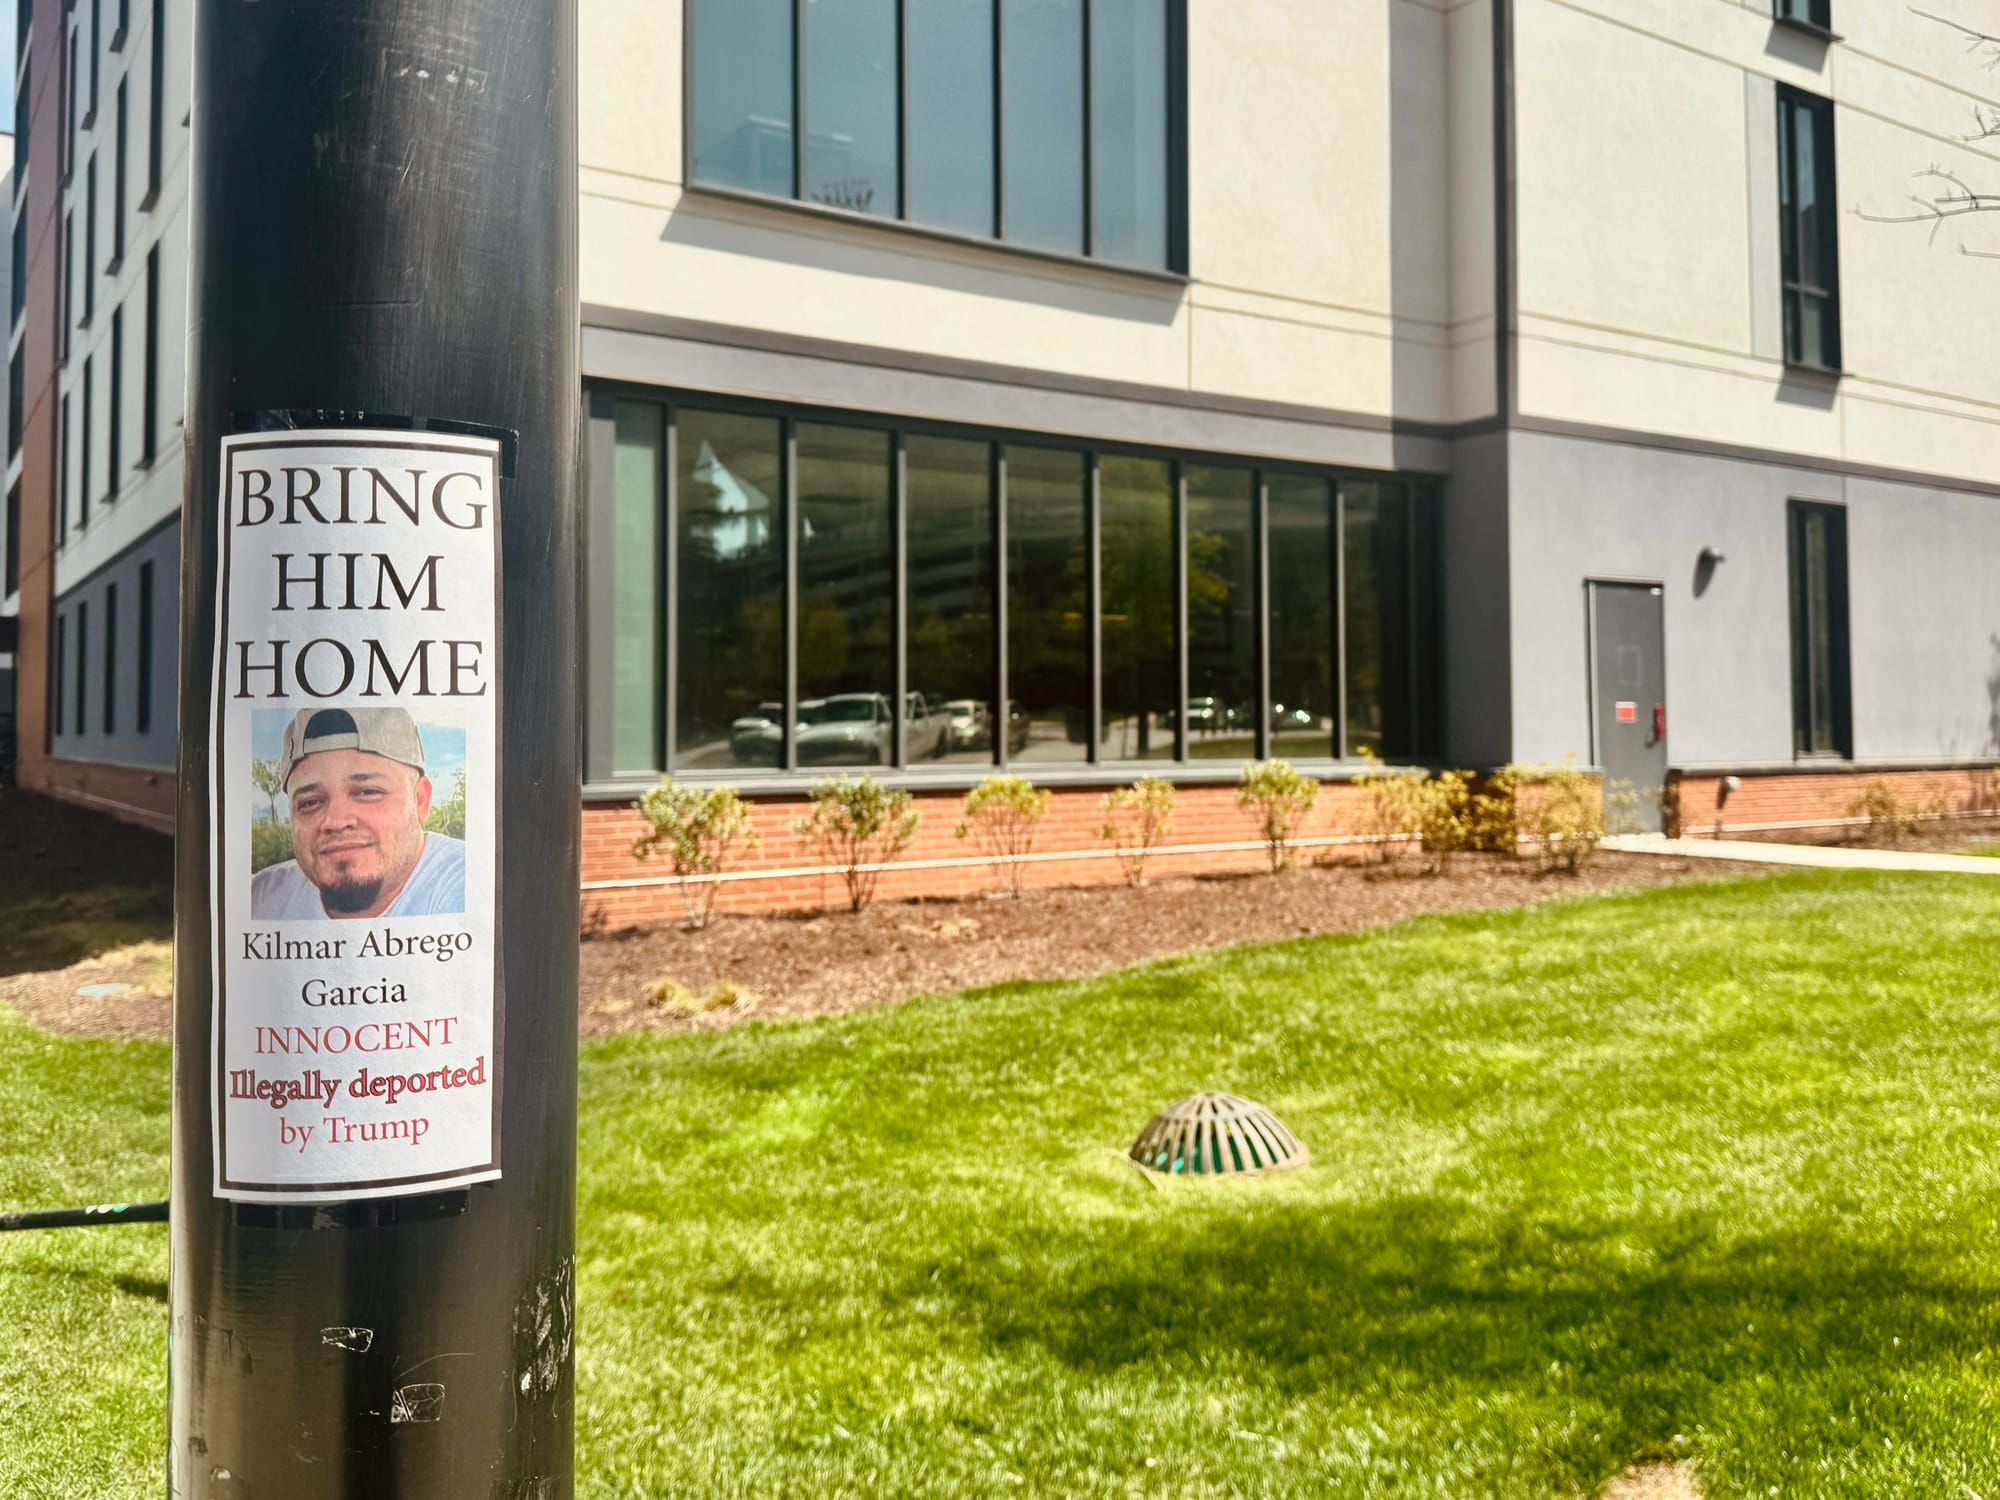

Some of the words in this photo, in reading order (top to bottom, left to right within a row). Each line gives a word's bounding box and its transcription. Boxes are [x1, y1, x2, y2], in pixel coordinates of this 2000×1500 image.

[236, 467, 487, 530] BRING
[271, 553, 446, 612] HIM
[233, 638, 487, 698] HOME
[242, 931, 346, 960] Kilmar
[356, 928, 473, 962] Abrego
[301, 977, 408, 1007] Garcia
[255, 1016, 458, 1055] INNOCENT
[229, 1067, 342, 1110] Illegally
[349, 1055, 487, 1105] deported
[280, 1116, 314, 1153] by
[322, 1115, 430, 1146] Trump
